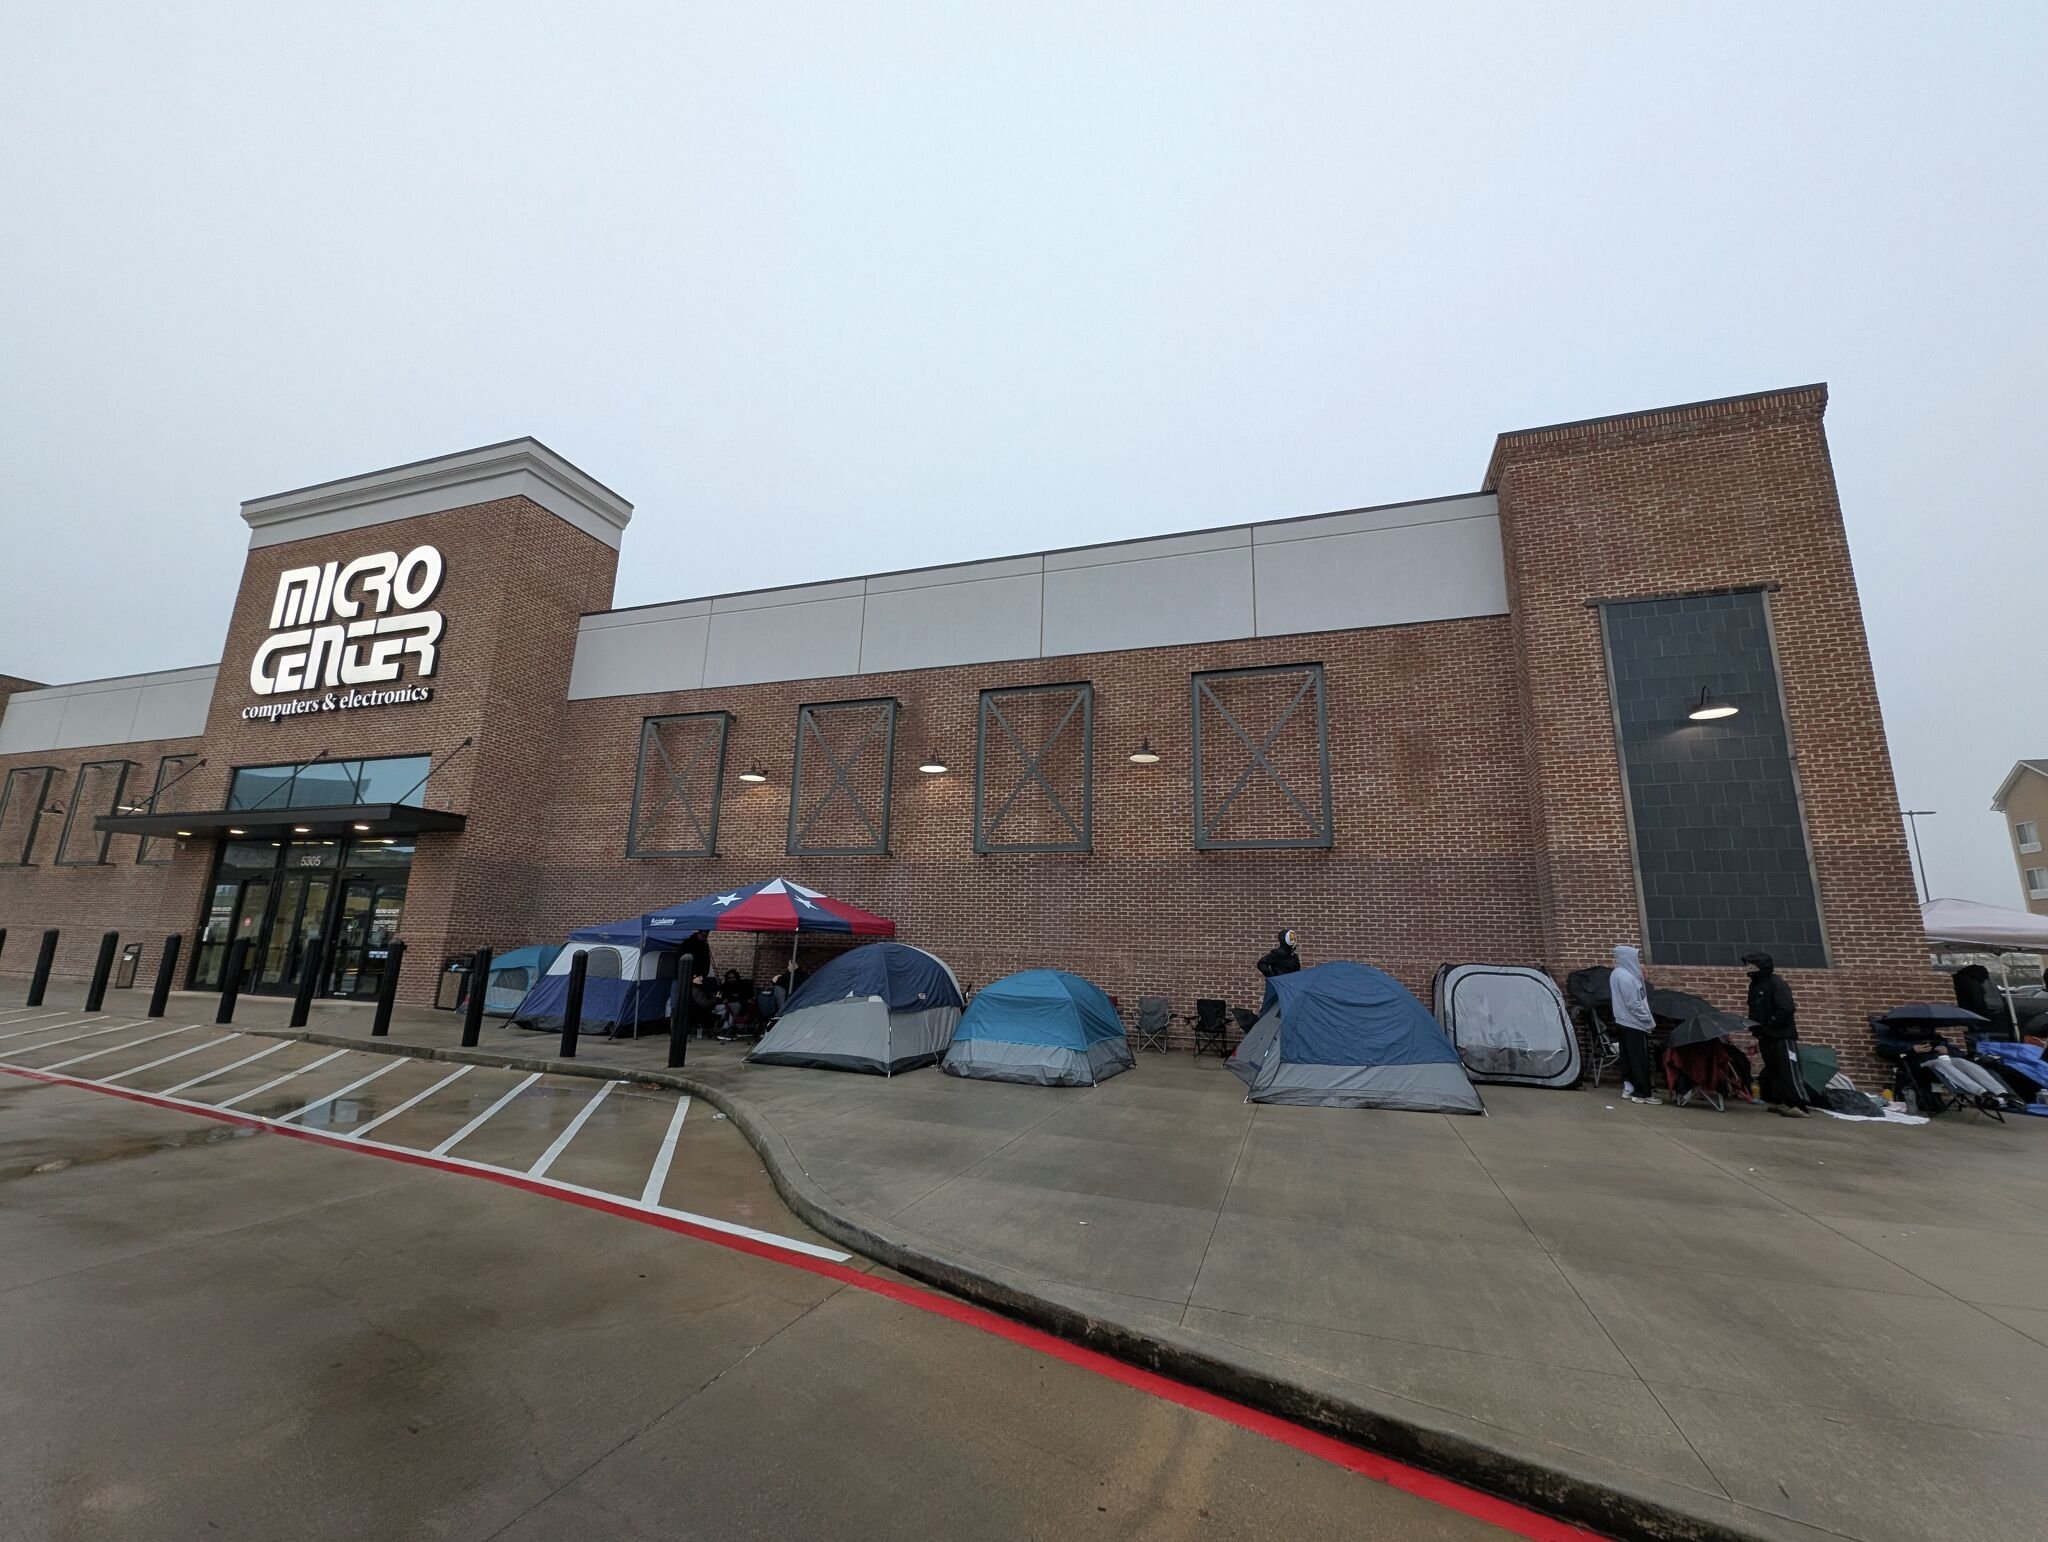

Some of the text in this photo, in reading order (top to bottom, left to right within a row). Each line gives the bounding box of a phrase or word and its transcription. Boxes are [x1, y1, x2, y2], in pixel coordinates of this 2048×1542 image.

[269, 545, 443, 630] MICRO
[250, 610, 443, 695] CENTER
[241, 684, 429, 722] computers & electronics
[300, 855, 321, 867] 5305
